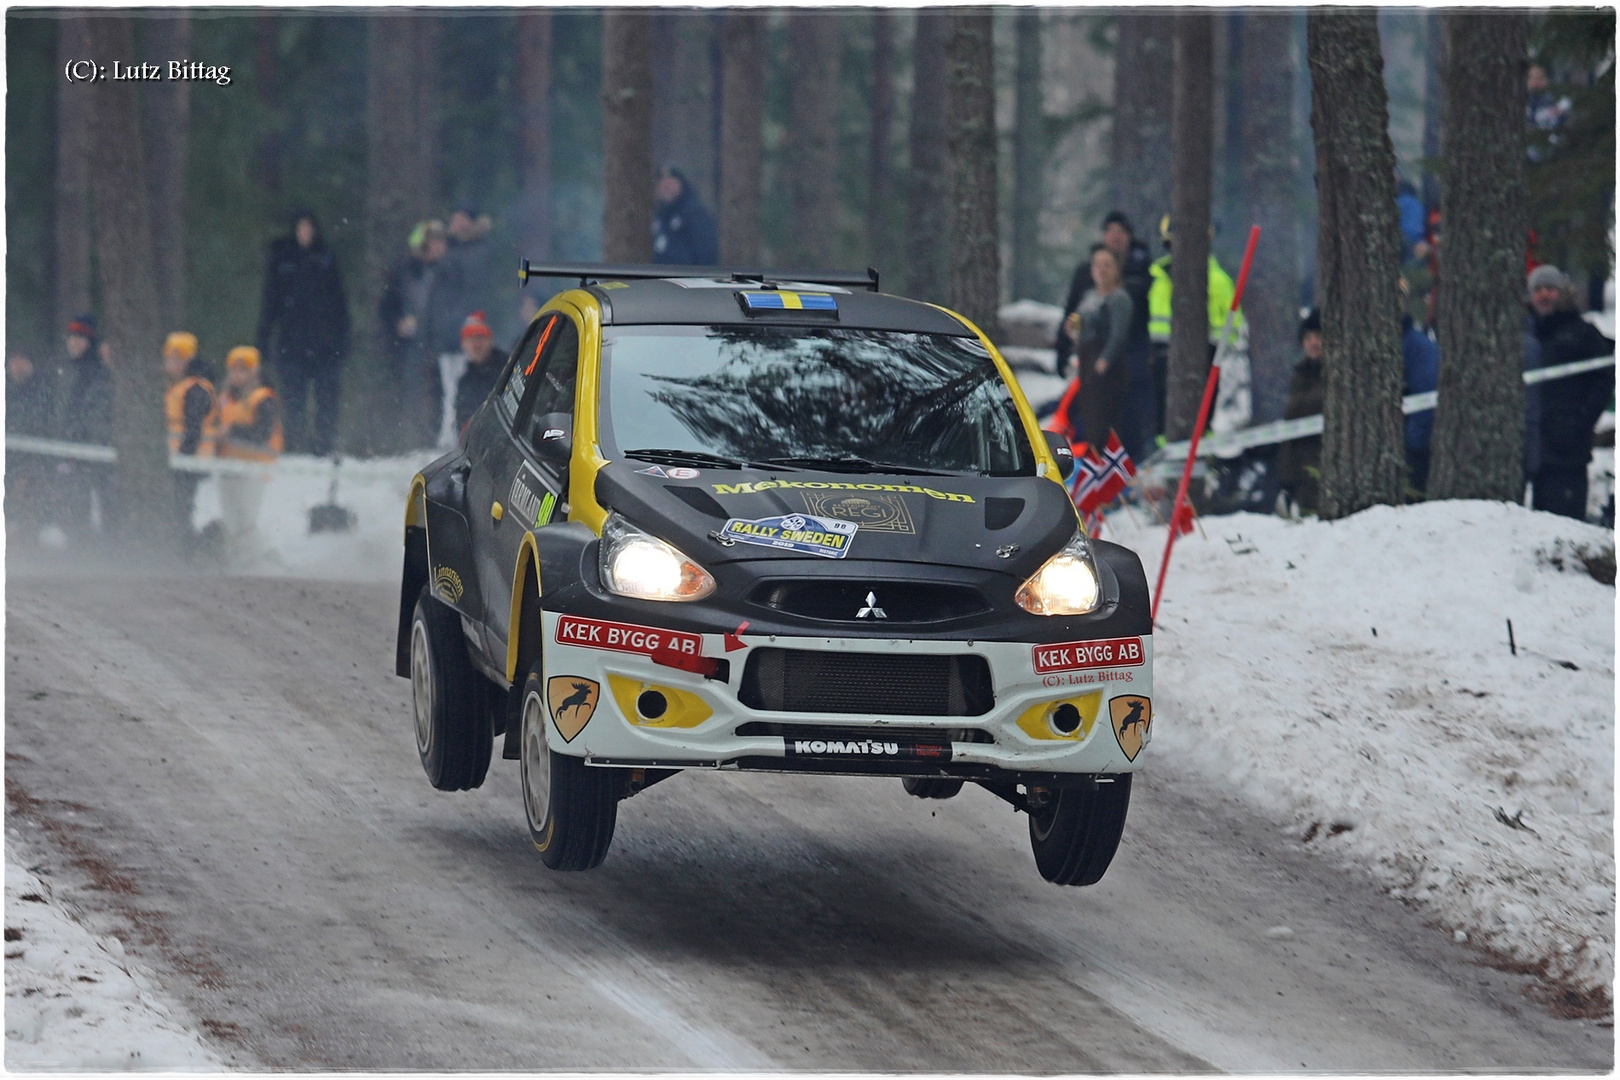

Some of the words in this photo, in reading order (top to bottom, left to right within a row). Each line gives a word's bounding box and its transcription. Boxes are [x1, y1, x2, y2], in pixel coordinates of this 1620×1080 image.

[711, 480, 976, 503] Mekonomen
[832, 506, 887, 518] REGI
[731, 521, 779, 538] RALLY
[780, 530, 846, 548] SWEDEN
[772, 540, 795, 548] 2019
[562, 621, 602, 642] KEK
[607, 628, 660, 650] BYGG
[668, 637, 697, 656] AB
[1038, 648, 1072, 668] KEK
[1075, 645, 1113, 664] BYGG
[1118, 643, 1140, 660] AB
[795, 739, 899, 755] KOMATSU
